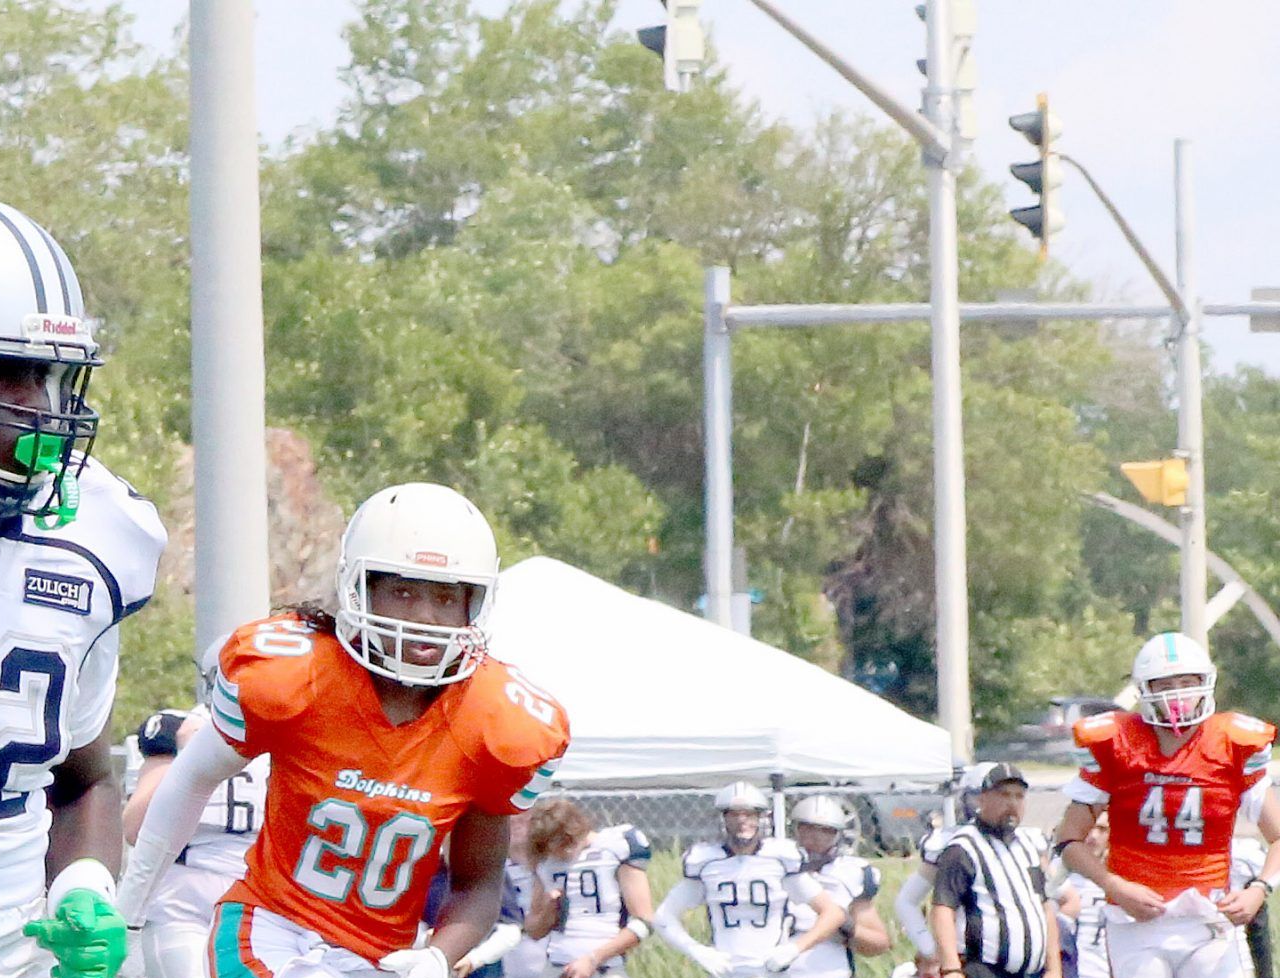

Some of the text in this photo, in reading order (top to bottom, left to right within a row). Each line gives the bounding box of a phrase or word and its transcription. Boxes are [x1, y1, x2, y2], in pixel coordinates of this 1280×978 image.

[27, 576, 80, 599] ZULICH
[334, 768, 433, 803] Dolphins
[1137, 786, 1205, 846] 44
[293, 797, 436, 910] 20
[718, 880, 770, 928] 29
